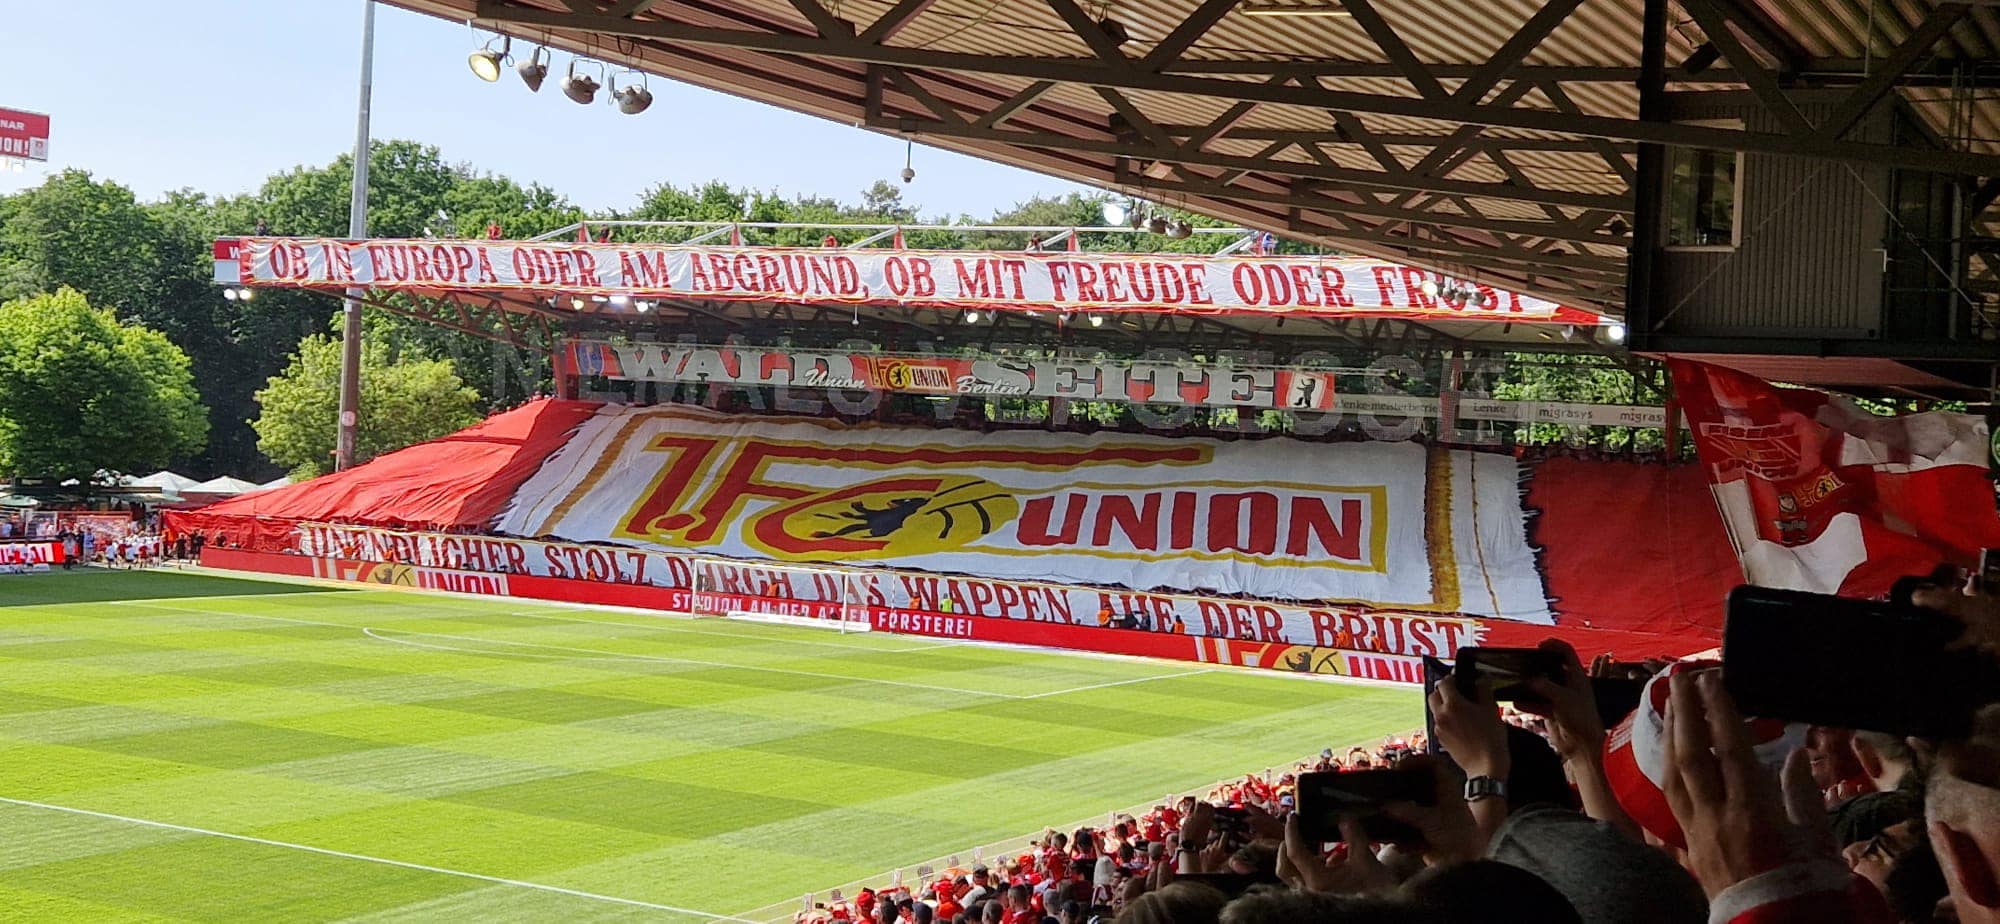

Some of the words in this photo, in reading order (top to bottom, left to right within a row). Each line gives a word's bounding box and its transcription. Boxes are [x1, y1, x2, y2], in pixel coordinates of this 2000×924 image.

[269, 243, 310, 279] OB
[322, 244, 356, 281] IN
[368, 245, 499, 283] EUROPA
[512, 246, 602, 287] ODER
[619, 250, 671, 289] AM
[690, 252, 870, 298] ABGRUND,
[884, 256, 936, 297] OB
[953, 257, 1028, 300] MIT
[1045, 260, 1214, 305] FREUDE
[1231, 262, 1354, 308] ODER
[608, 342, 856, 386] WALD
[804, 367, 866, 390] Union
[911, 367, 951, 389] UNION
[956, 374, 1022, 395] Berlin
[970, 358, 1275, 407] SEITE
[1016, 490, 1364, 562] UNION
[543, 543, 654, 588] STOLZ
[811, 571, 886, 607] DAS
[900, 574, 1073, 626] WAPPEN
[1197, 599, 1290, 645] DER
[1308, 609, 1466, 660] BRUST
[750, 599, 772, 615] AN
[817, 605, 871, 623] ALEN
